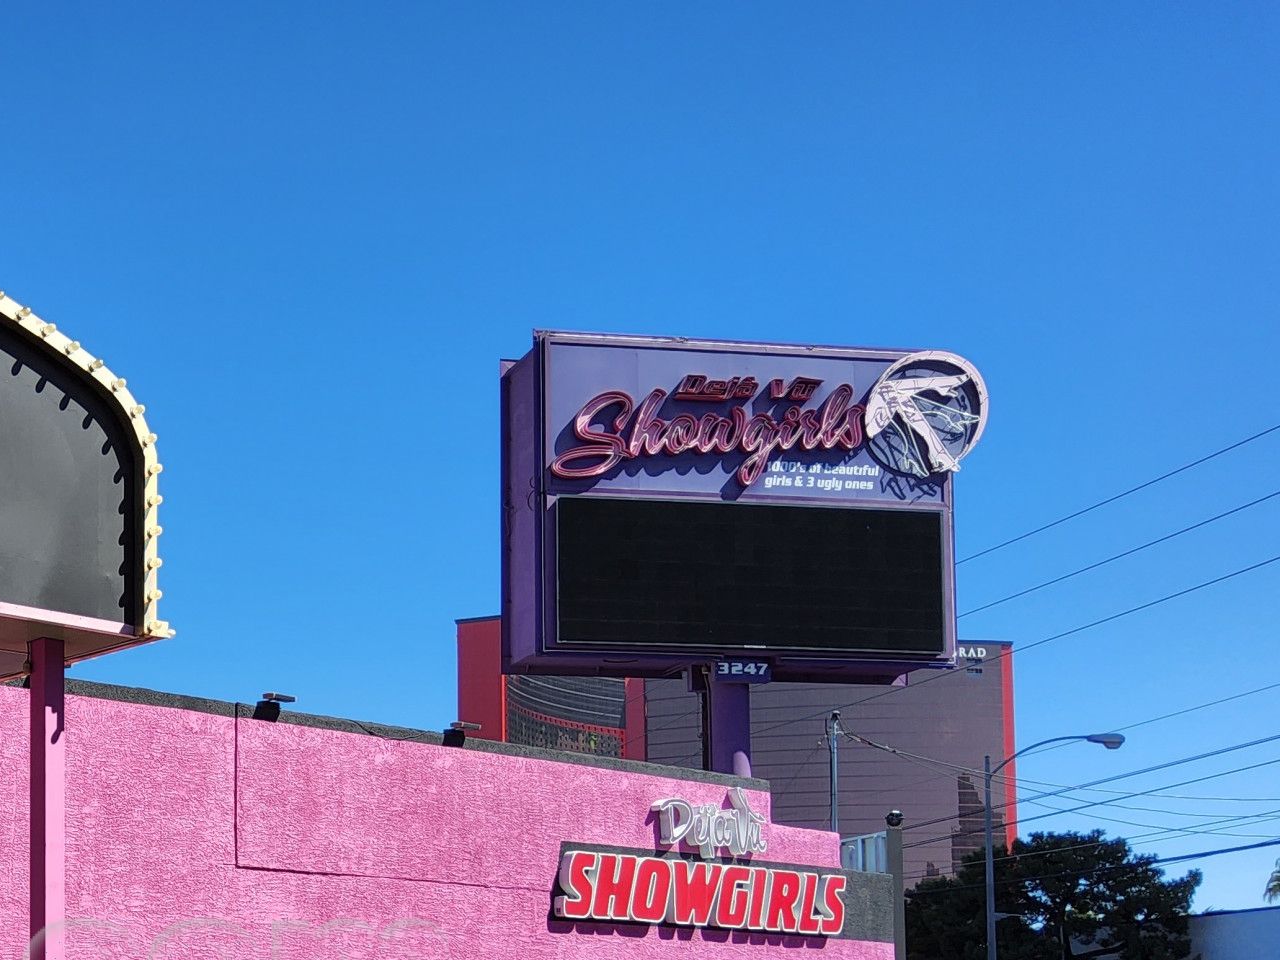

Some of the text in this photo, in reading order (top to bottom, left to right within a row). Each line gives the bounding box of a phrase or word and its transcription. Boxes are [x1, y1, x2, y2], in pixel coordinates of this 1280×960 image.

[770, 376, 825, 401] Vu
[551, 383, 867, 487] Showgirls
[824, 463, 880, 477] beautiful
[765, 475, 874, 491] girls & 3 ugly ones
[958, 646, 987, 658] RAD
[717, 661, 768, 675] 3247
[556, 850, 847, 935] SHOWGIRLS
